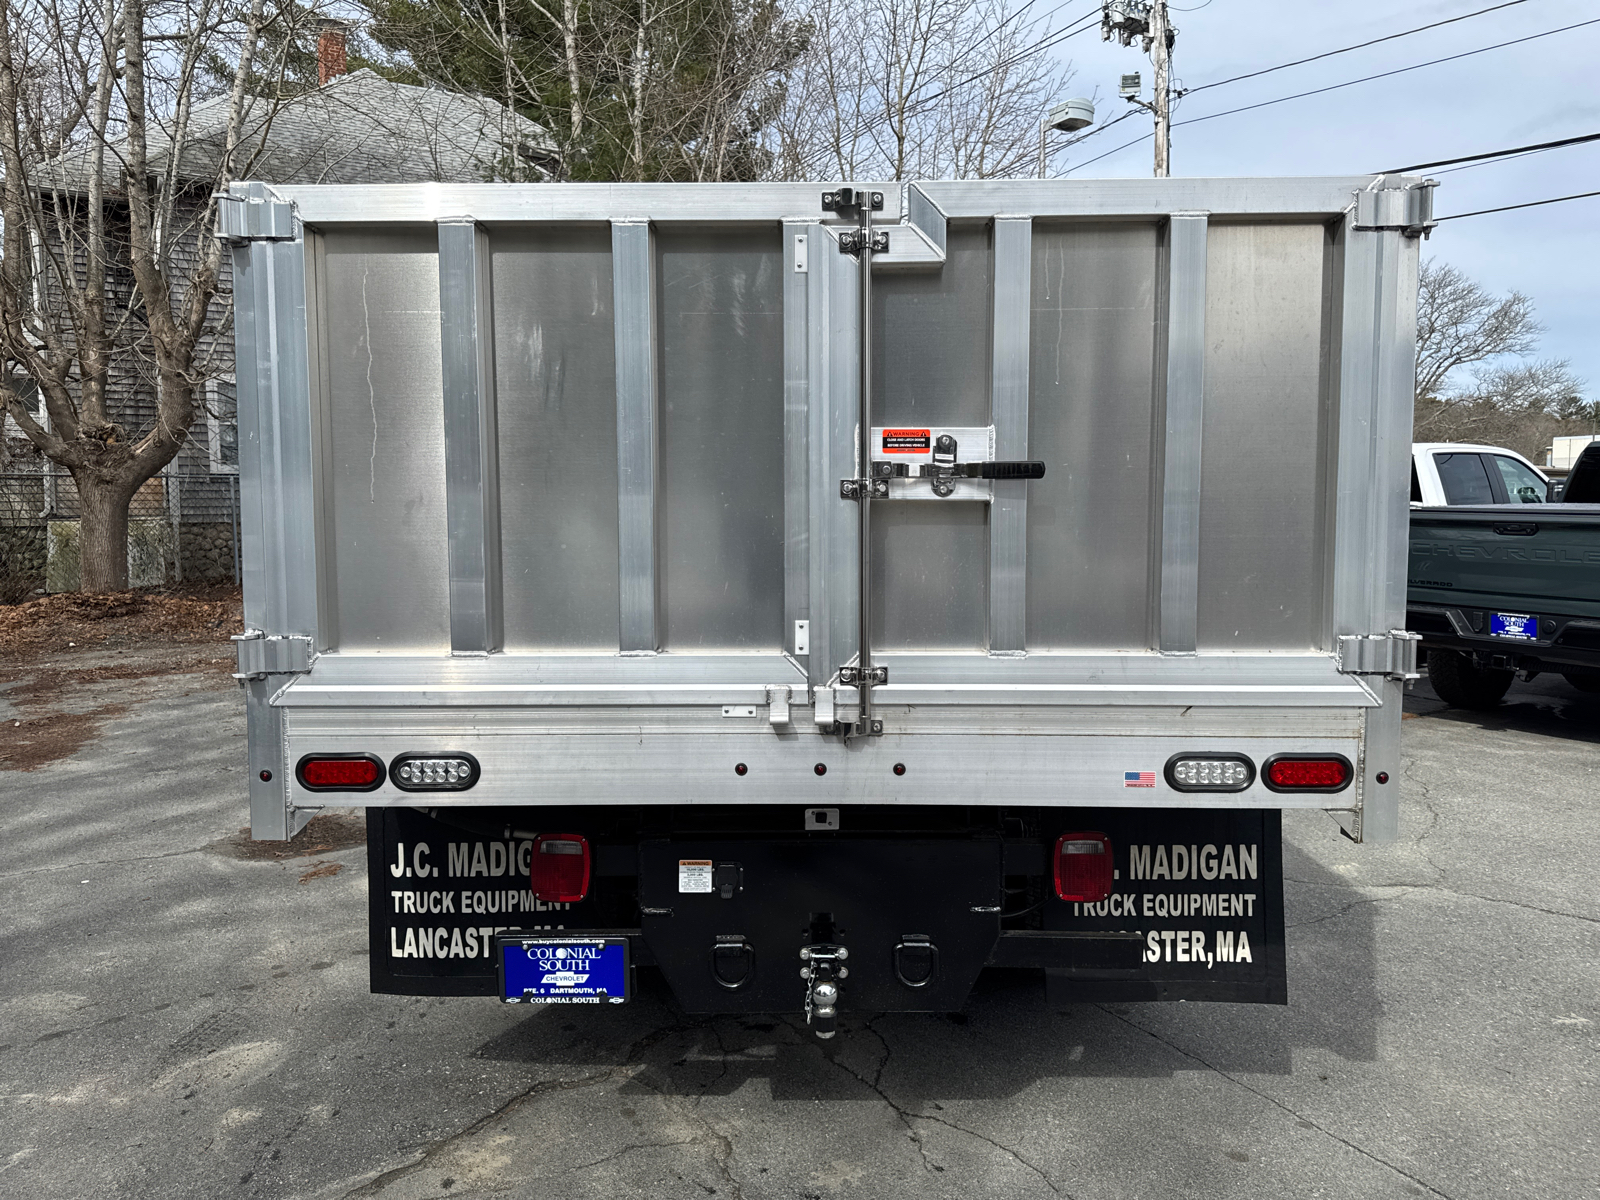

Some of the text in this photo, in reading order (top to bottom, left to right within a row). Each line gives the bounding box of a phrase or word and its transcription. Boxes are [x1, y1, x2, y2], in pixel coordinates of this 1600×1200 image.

[1411, 542, 1600, 564] CHEVROLE
[1407, 579, 1453, 587] ILVERADO
[390, 841, 534, 878] J.C. MADIG
[1129, 844, 1258, 880] MADIGAN
[391, 891, 455, 914] TRUCK
[1143, 893, 1257, 918] EQUIPMENT
[527, 947, 601, 960] COLONIAL
[1128, 931, 1253, 969] STER,MA
[539, 960, 590, 971] SOUTH
